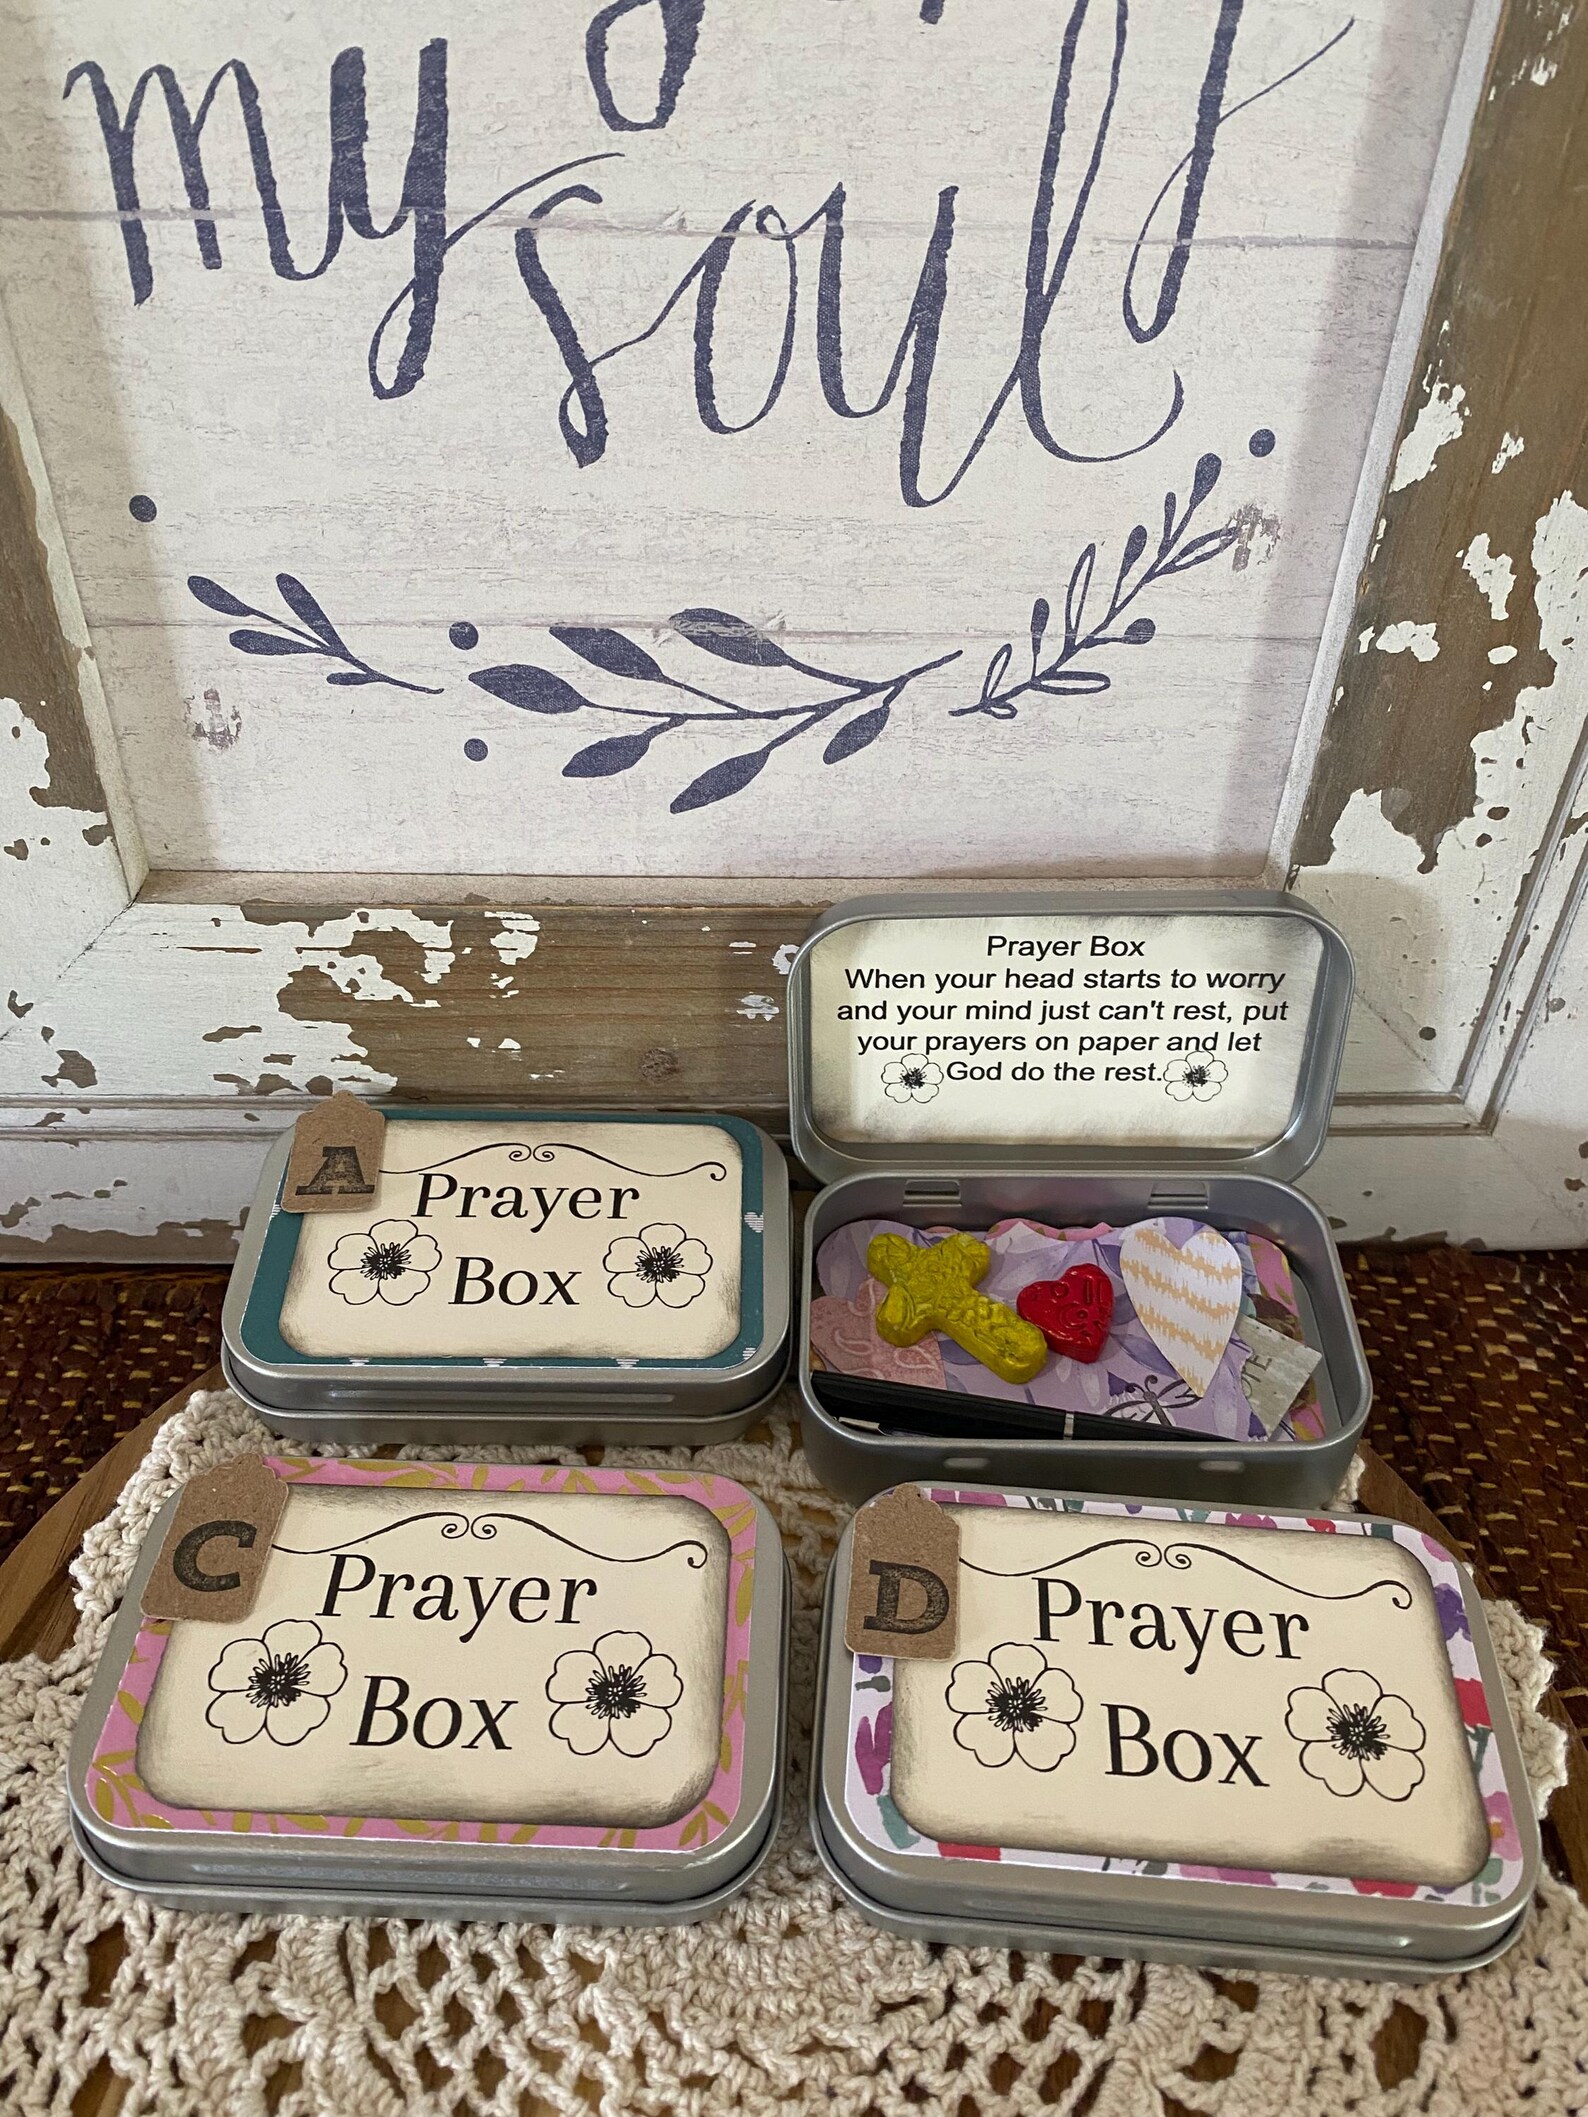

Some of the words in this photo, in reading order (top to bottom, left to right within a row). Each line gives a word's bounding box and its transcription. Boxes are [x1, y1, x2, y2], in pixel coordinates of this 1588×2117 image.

[62, 37, 626, 400] my
[514, 0, 1184, 508] soul
[987, 935, 1083, 962] Prayer
[1089, 935, 1146, 957] Box
[844, 968, 925, 989] When
[934, 973, 998, 995] your
[1004, 967, 1075, 989] head
[1083, 968, 1161, 989] starts
[1170, 968, 1197, 989] to
[1206, 972, 1287, 995] worry
[836, 999, 888, 1021] and
[896, 1004, 958, 1026] your
[965, 999, 1032, 1021] mind
[1037, 999, 1091, 1026] just
[1098, 999, 1166, 1021] can't
[1172, 1000, 1232, 1024] rest,
[1242, 1000, 1289, 1026] put
[857, 1035, 918, 1056] your
[925, 1035, 1027, 1056] prayers
[1035, 1035, 1069, 1052] on
[1078, 1035, 1160, 1056] paper
[1166, 1032, 1218, 1052] and
[1227, 1031, 1263, 1052] let
[946, 1061, 1003, 1081] God
[1011, 1061, 1045, 1082] do
[1053, 1061, 1096, 1082] the
[1104, 1062, 1163, 1082] rest.
[295, 1145, 376, 1196] A
[410, 1172, 640, 1234] Prayer
[447, 1256, 583, 1306] Box
[172, 1519, 258, 1593] C
[314, 1553, 598, 1644] Prayer
[862, 1559, 950, 1635] D
[1031, 1576, 1310, 1676] Prayer
[348, 1675, 519, 1751] Box
[1100, 1703, 1271, 1788] Box
